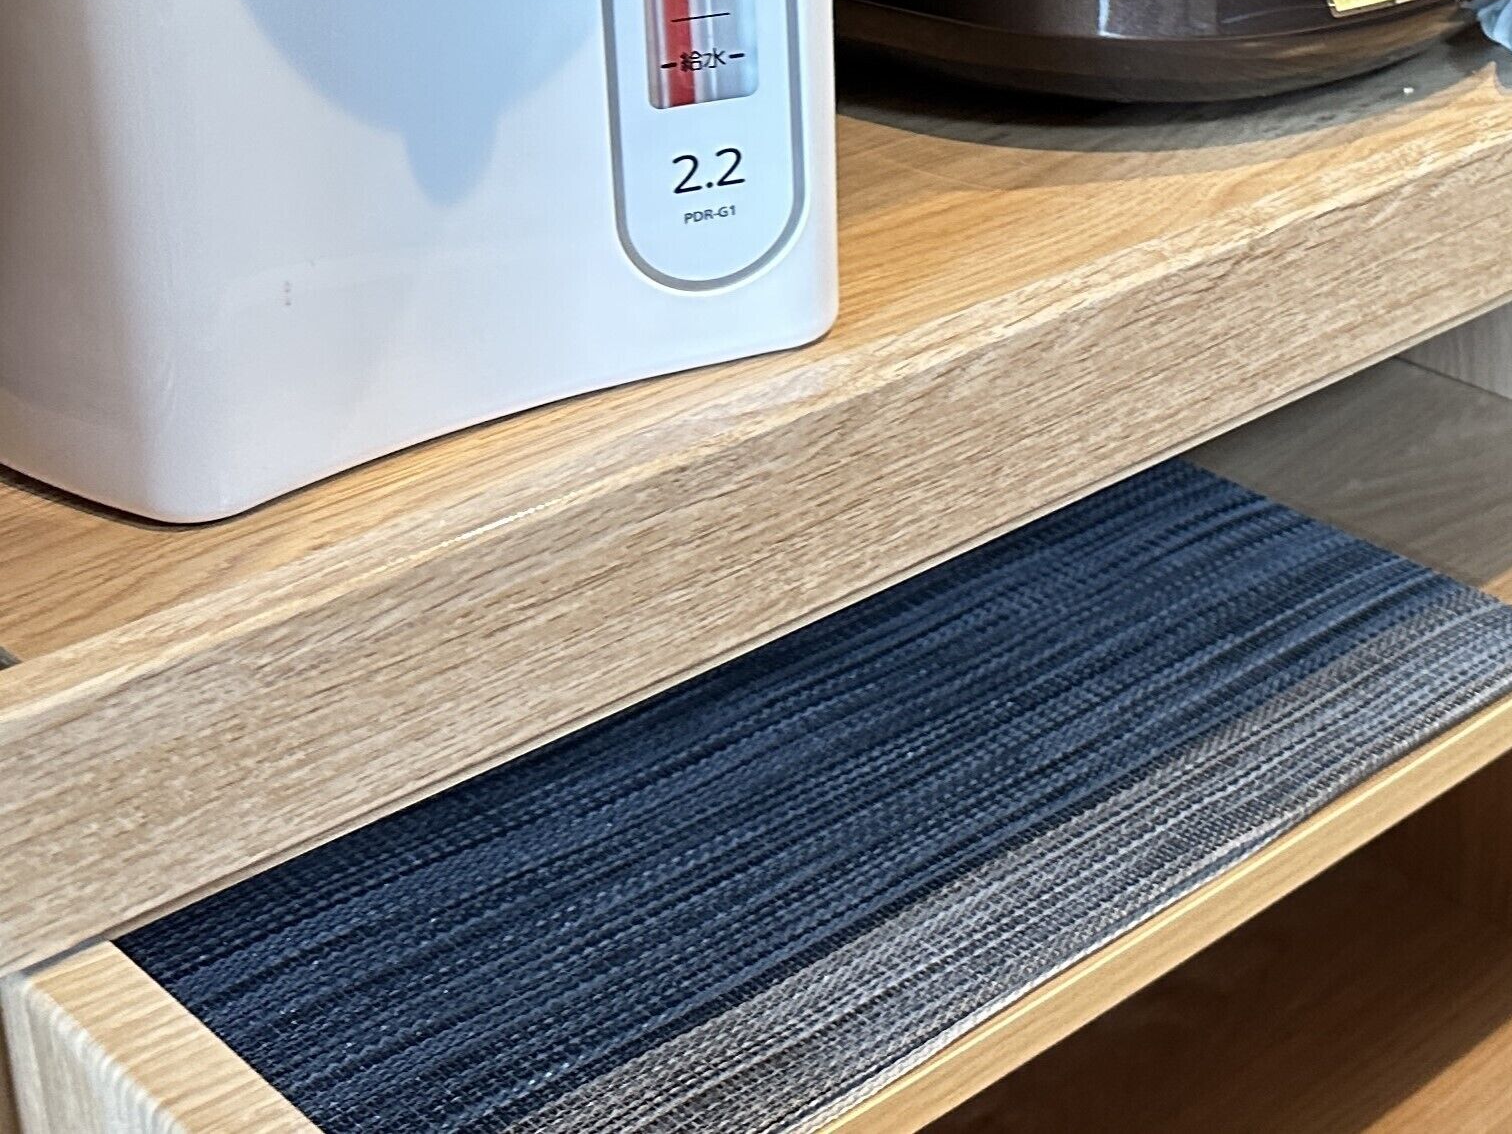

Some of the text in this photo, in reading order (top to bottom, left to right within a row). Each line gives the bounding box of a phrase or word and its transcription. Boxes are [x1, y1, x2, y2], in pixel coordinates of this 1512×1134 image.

[680, 48, 727, 72] 給水
[672, 147, 746, 195] 2.2
[684, 204, 737, 225] PDR-G1
